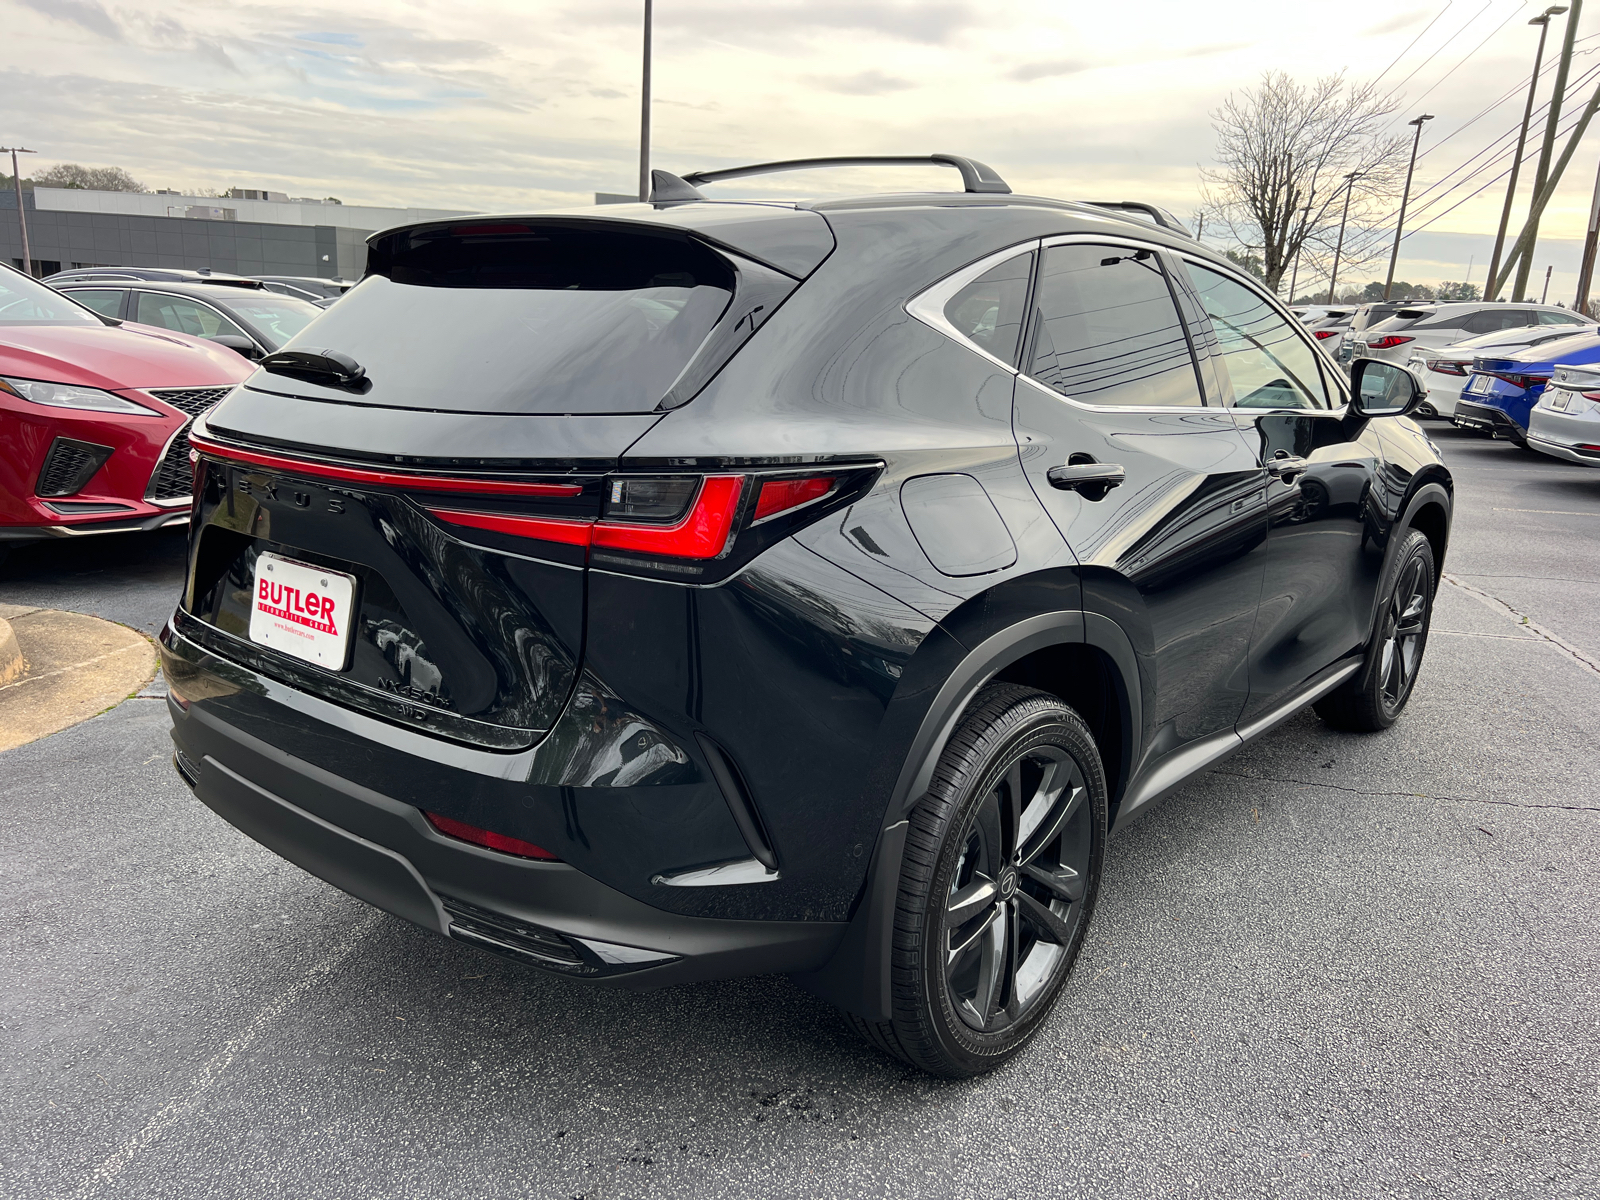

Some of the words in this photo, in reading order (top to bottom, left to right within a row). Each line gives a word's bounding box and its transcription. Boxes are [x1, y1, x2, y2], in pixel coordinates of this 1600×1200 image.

[257, 601, 303, 624] AUTOMOTIVE
[308, 619, 336, 634] GROUP
[273, 621, 315, 641] www.butlercars.com
